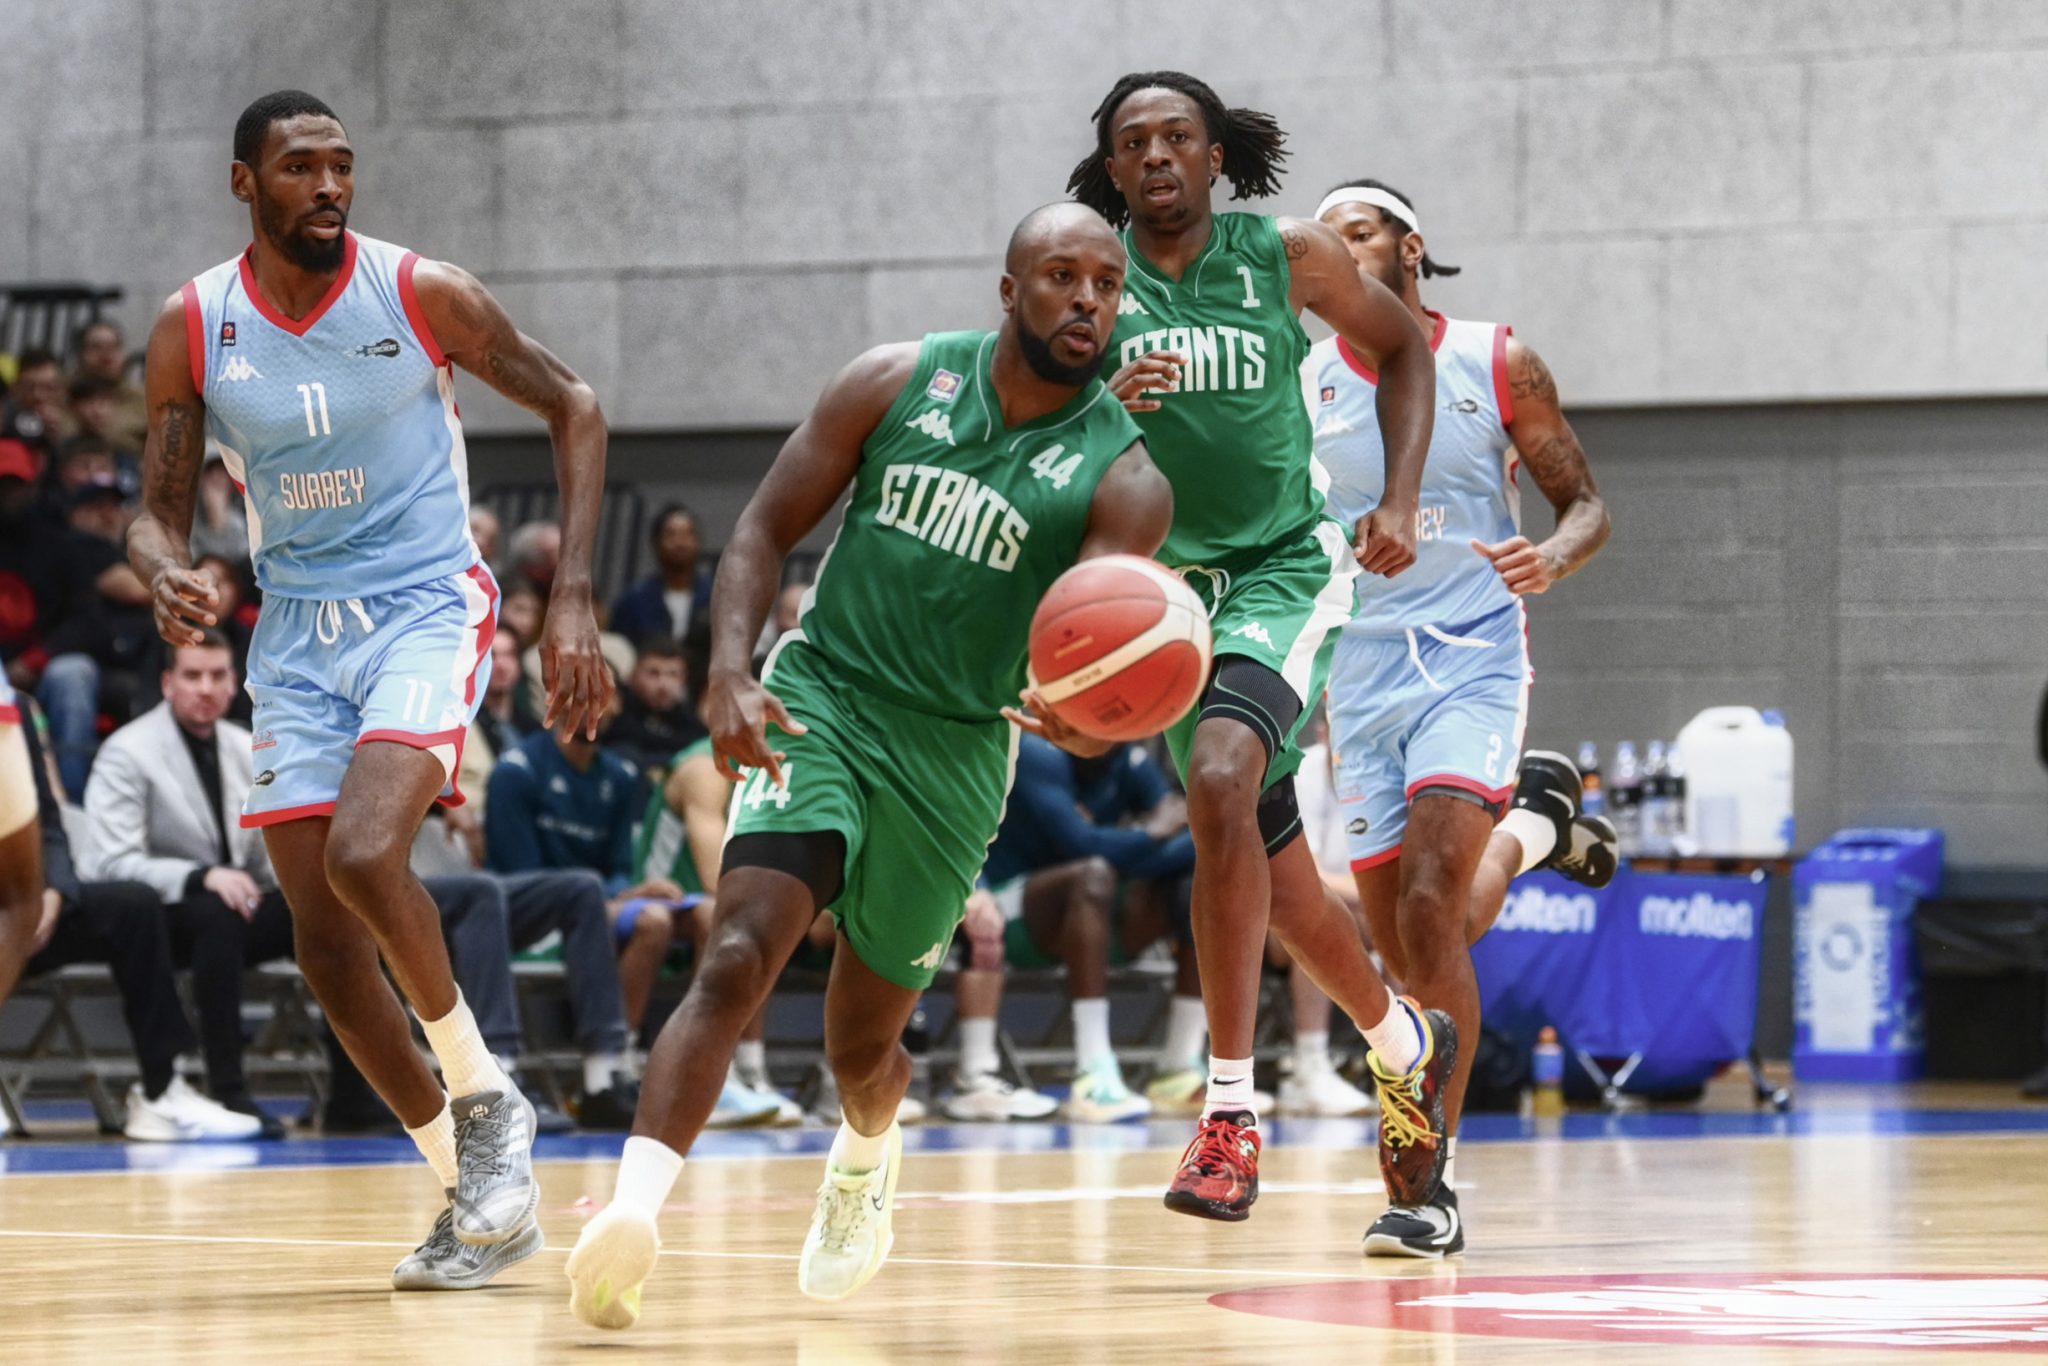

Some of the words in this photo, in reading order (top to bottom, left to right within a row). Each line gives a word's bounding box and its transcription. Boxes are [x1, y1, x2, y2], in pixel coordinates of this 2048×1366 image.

[1236, 265, 1261, 309] 1
[297, 382, 331, 437] 11
[279, 466, 366, 510] SURREY
[1028, 443, 1085, 490] 44
[874, 463, 1030, 572] GIANTS
[402, 678, 433, 725] 11
[1484, 733, 1502, 780] 2
[743, 762, 793, 810] 44
[1489, 886, 1597, 934] olten
[1638, 891, 1754, 941] molten
